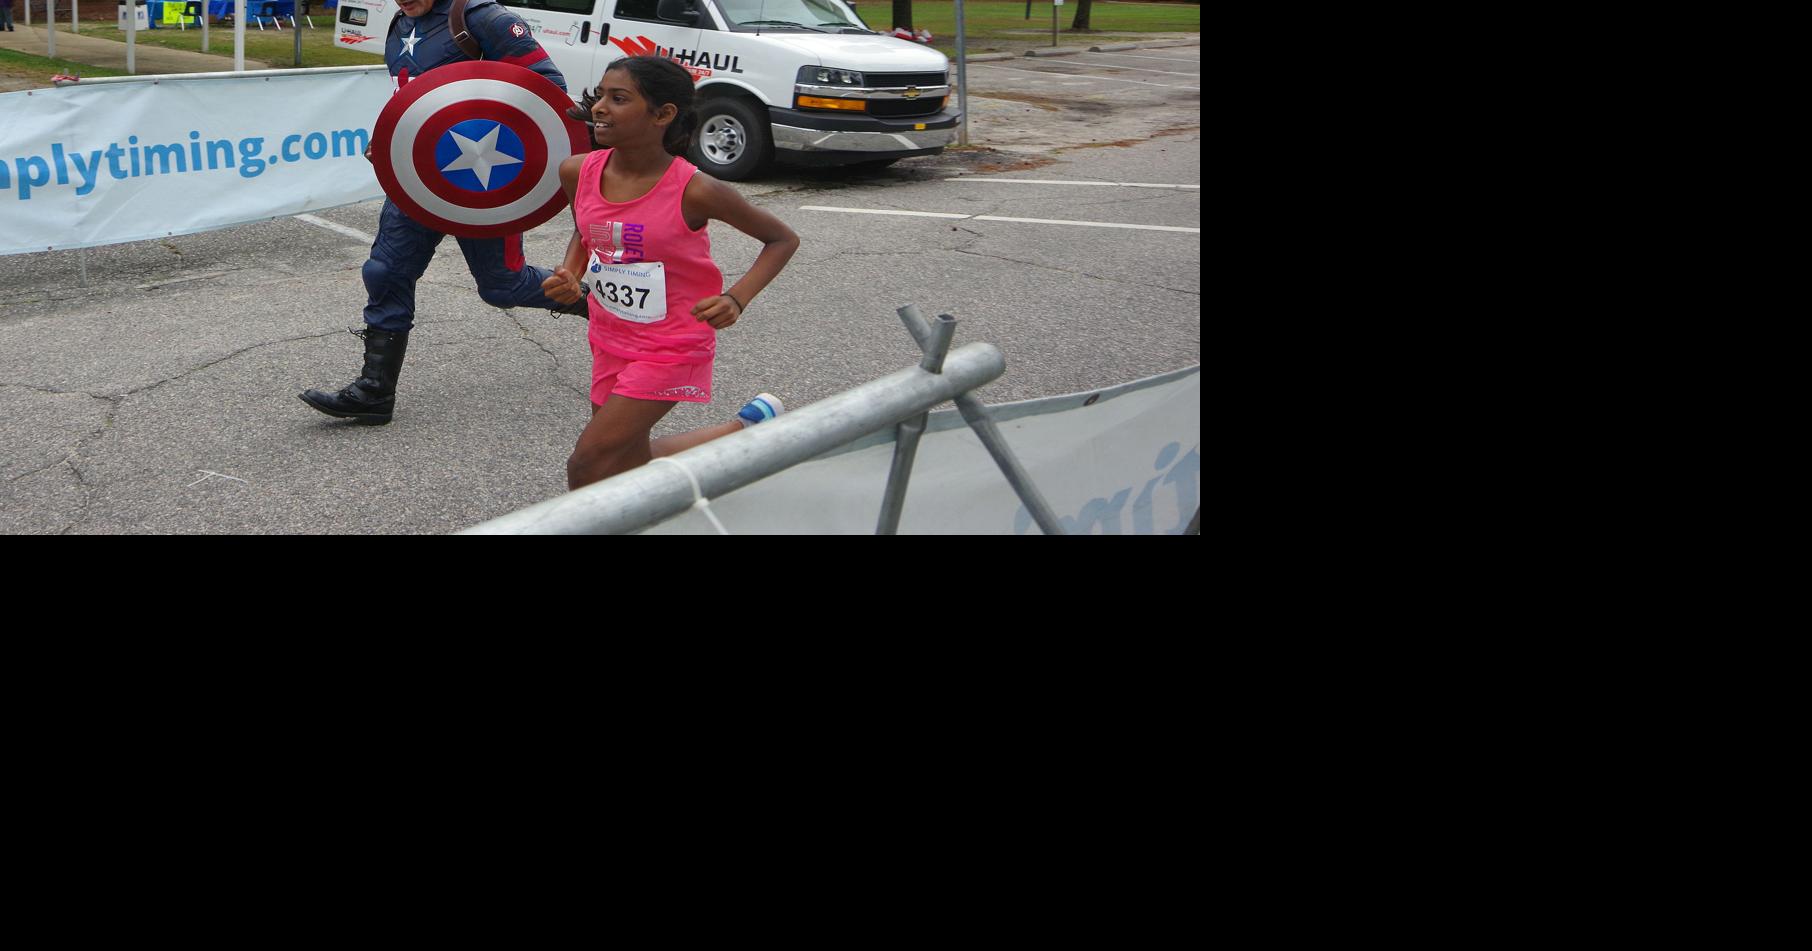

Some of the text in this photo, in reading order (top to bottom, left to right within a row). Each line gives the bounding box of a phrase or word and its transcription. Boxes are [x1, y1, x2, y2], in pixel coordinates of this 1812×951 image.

[656, 46, 743, 73] U-HAUL
[0, 125, 369, 201] plytiming.com
[603, 266, 651, 278] SIMPLY TIMING
[595, 280, 650, 309] 4337
